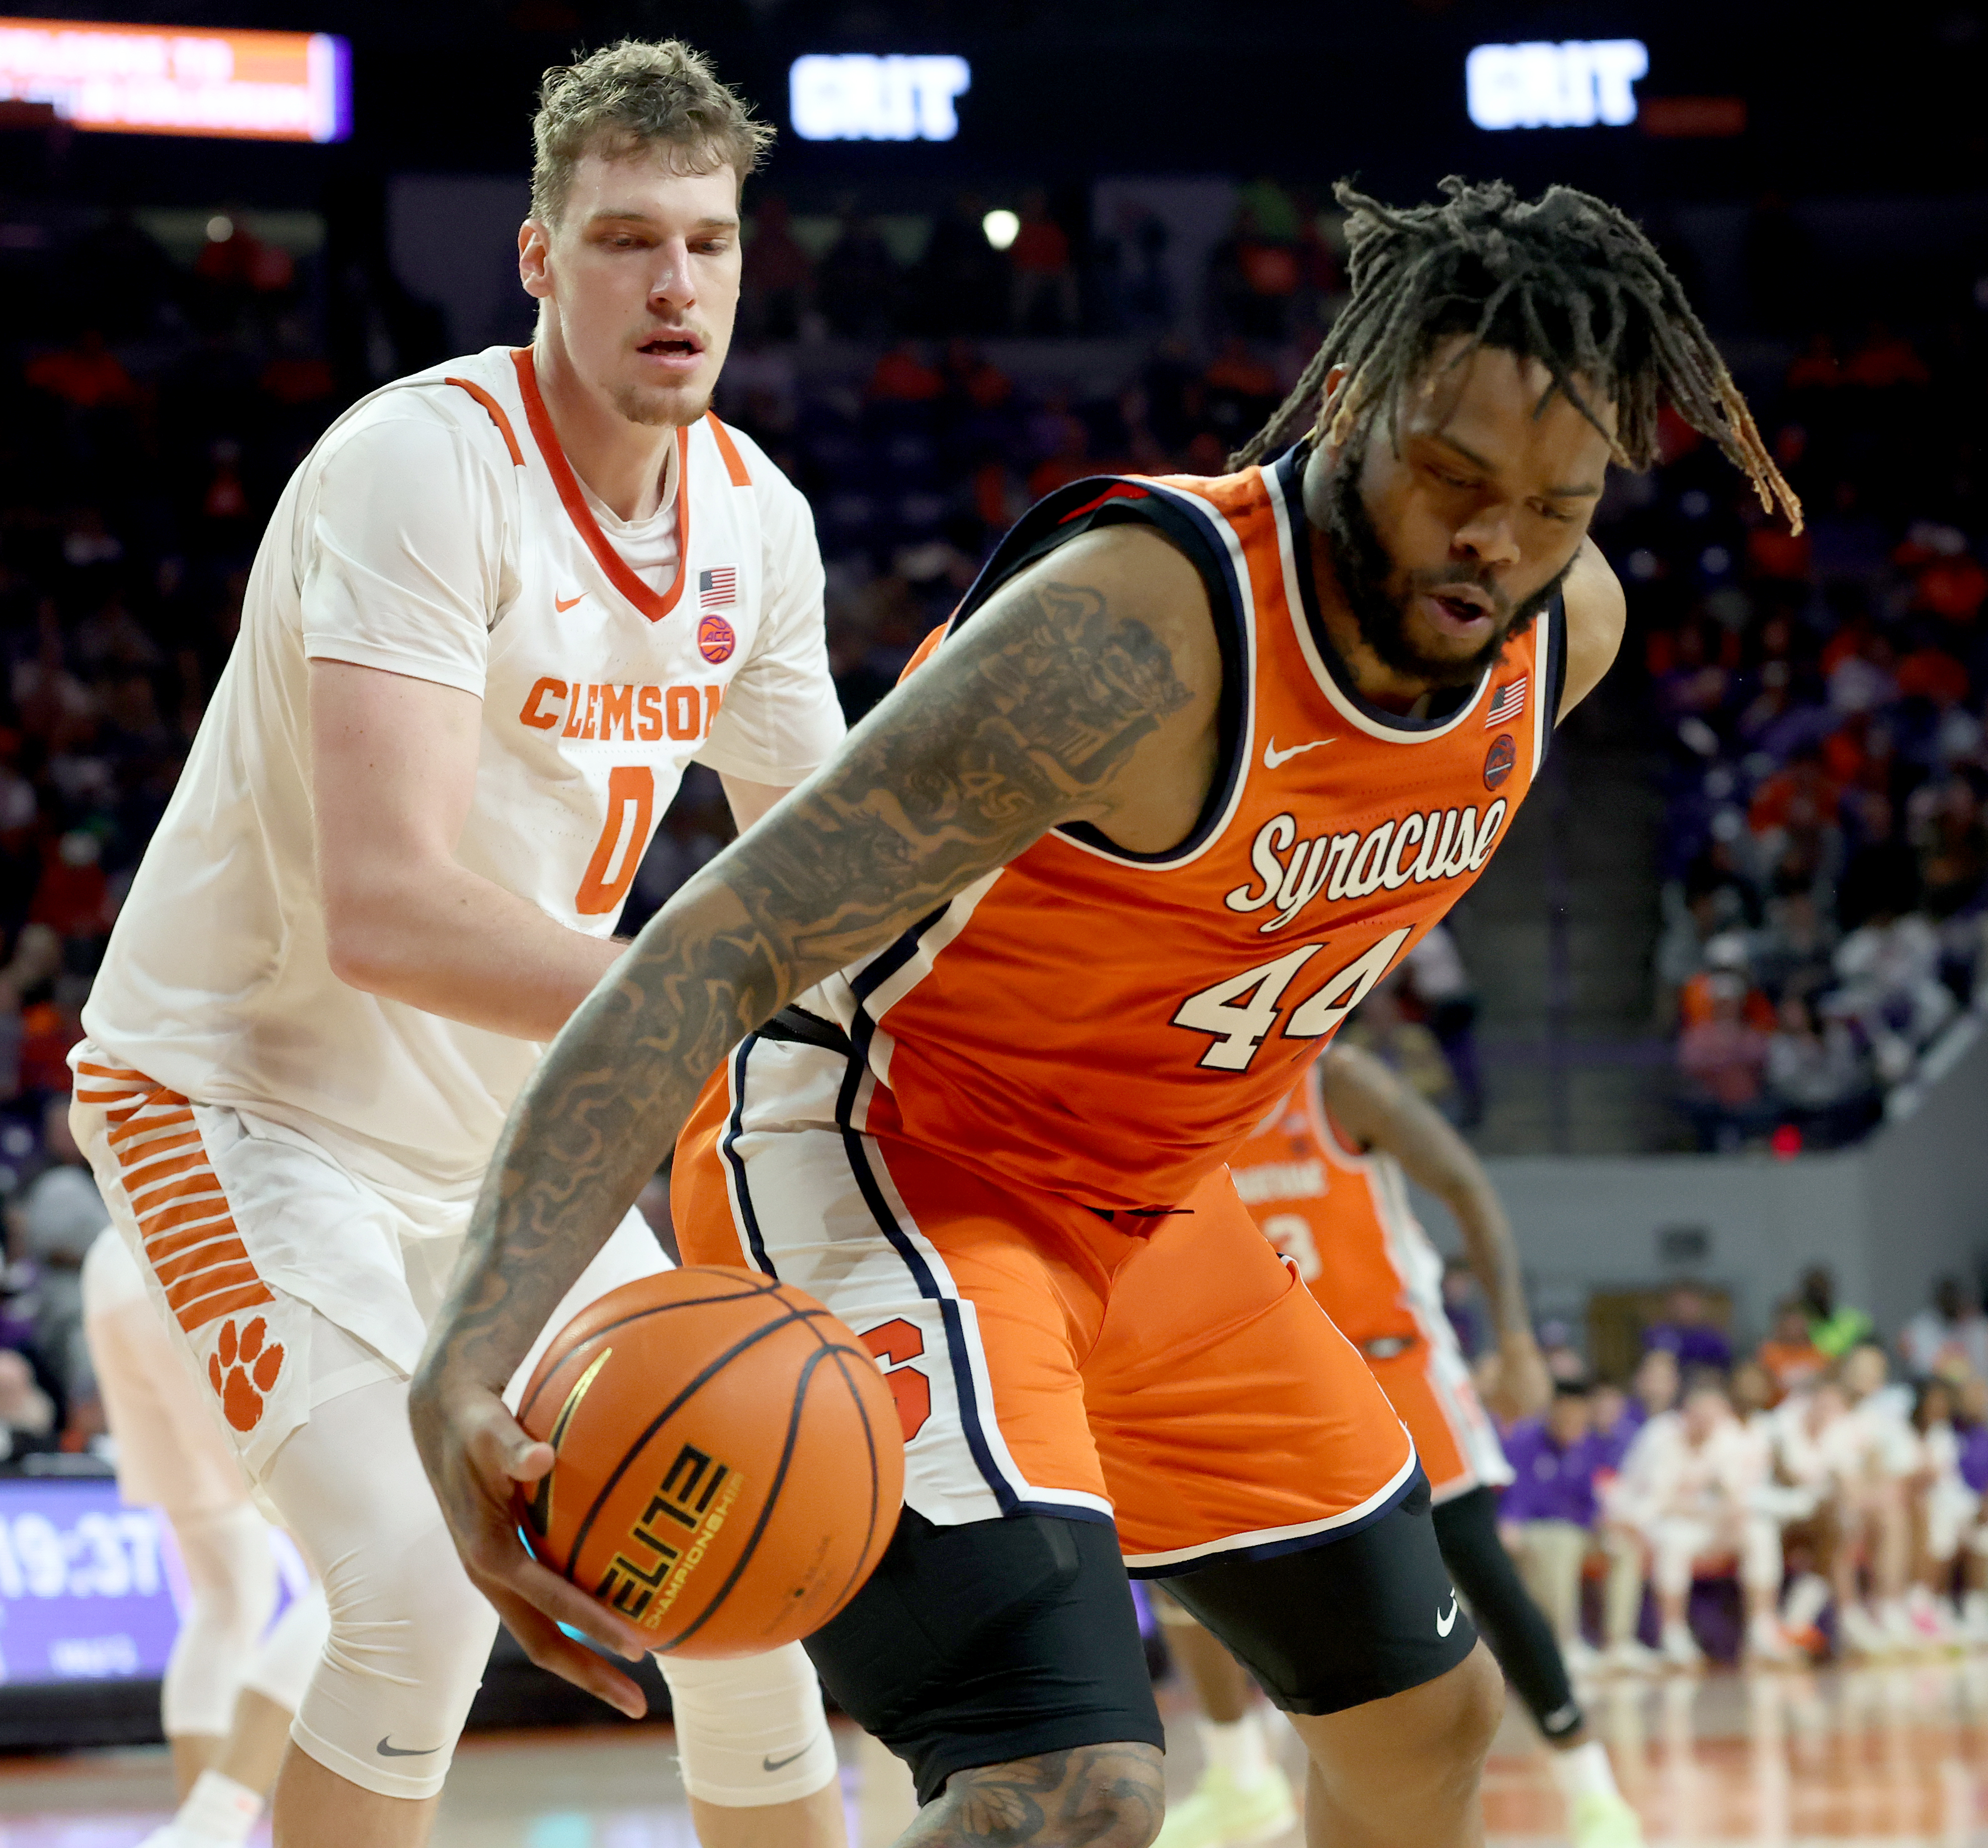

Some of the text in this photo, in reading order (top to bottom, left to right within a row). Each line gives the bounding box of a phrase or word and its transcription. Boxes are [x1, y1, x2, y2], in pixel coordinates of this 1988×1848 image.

[575, 766, 654, 915] 0
[1224, 797, 1508, 933] Syracuse
[1168, 923, 1417, 1074] 44
[594, 1442, 730, 1622] ELITE
[644, 1472, 745, 1630] CHAMPIONSHIP
